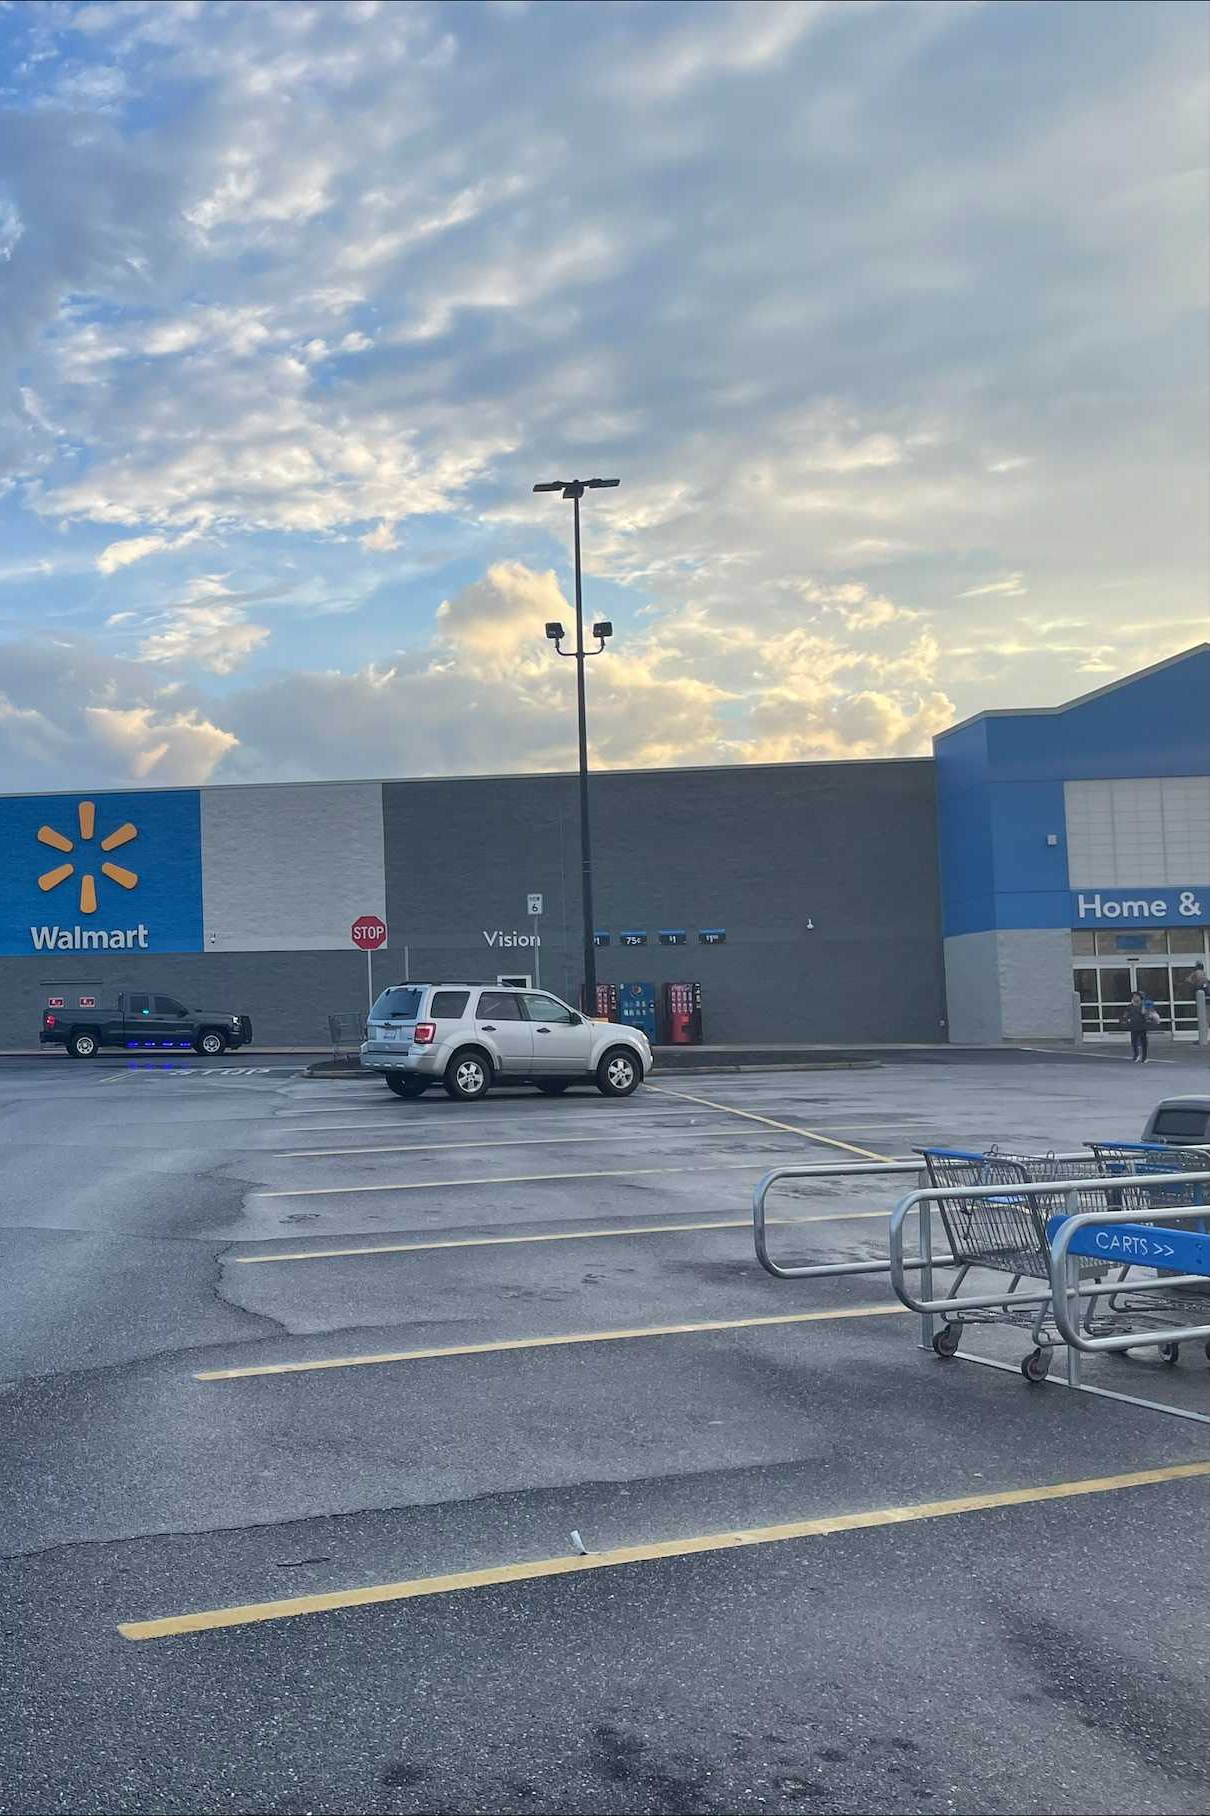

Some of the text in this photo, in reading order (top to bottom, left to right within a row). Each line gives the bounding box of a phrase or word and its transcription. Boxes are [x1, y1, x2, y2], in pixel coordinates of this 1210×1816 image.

[1077, 892, 1202, 918] Home &
[30, 924, 149, 950] Walmart
[353, 926, 385, 939] STOP
[482, 930, 541, 947] Vision
[1095, 1231, 1148, 1256] CARTS
